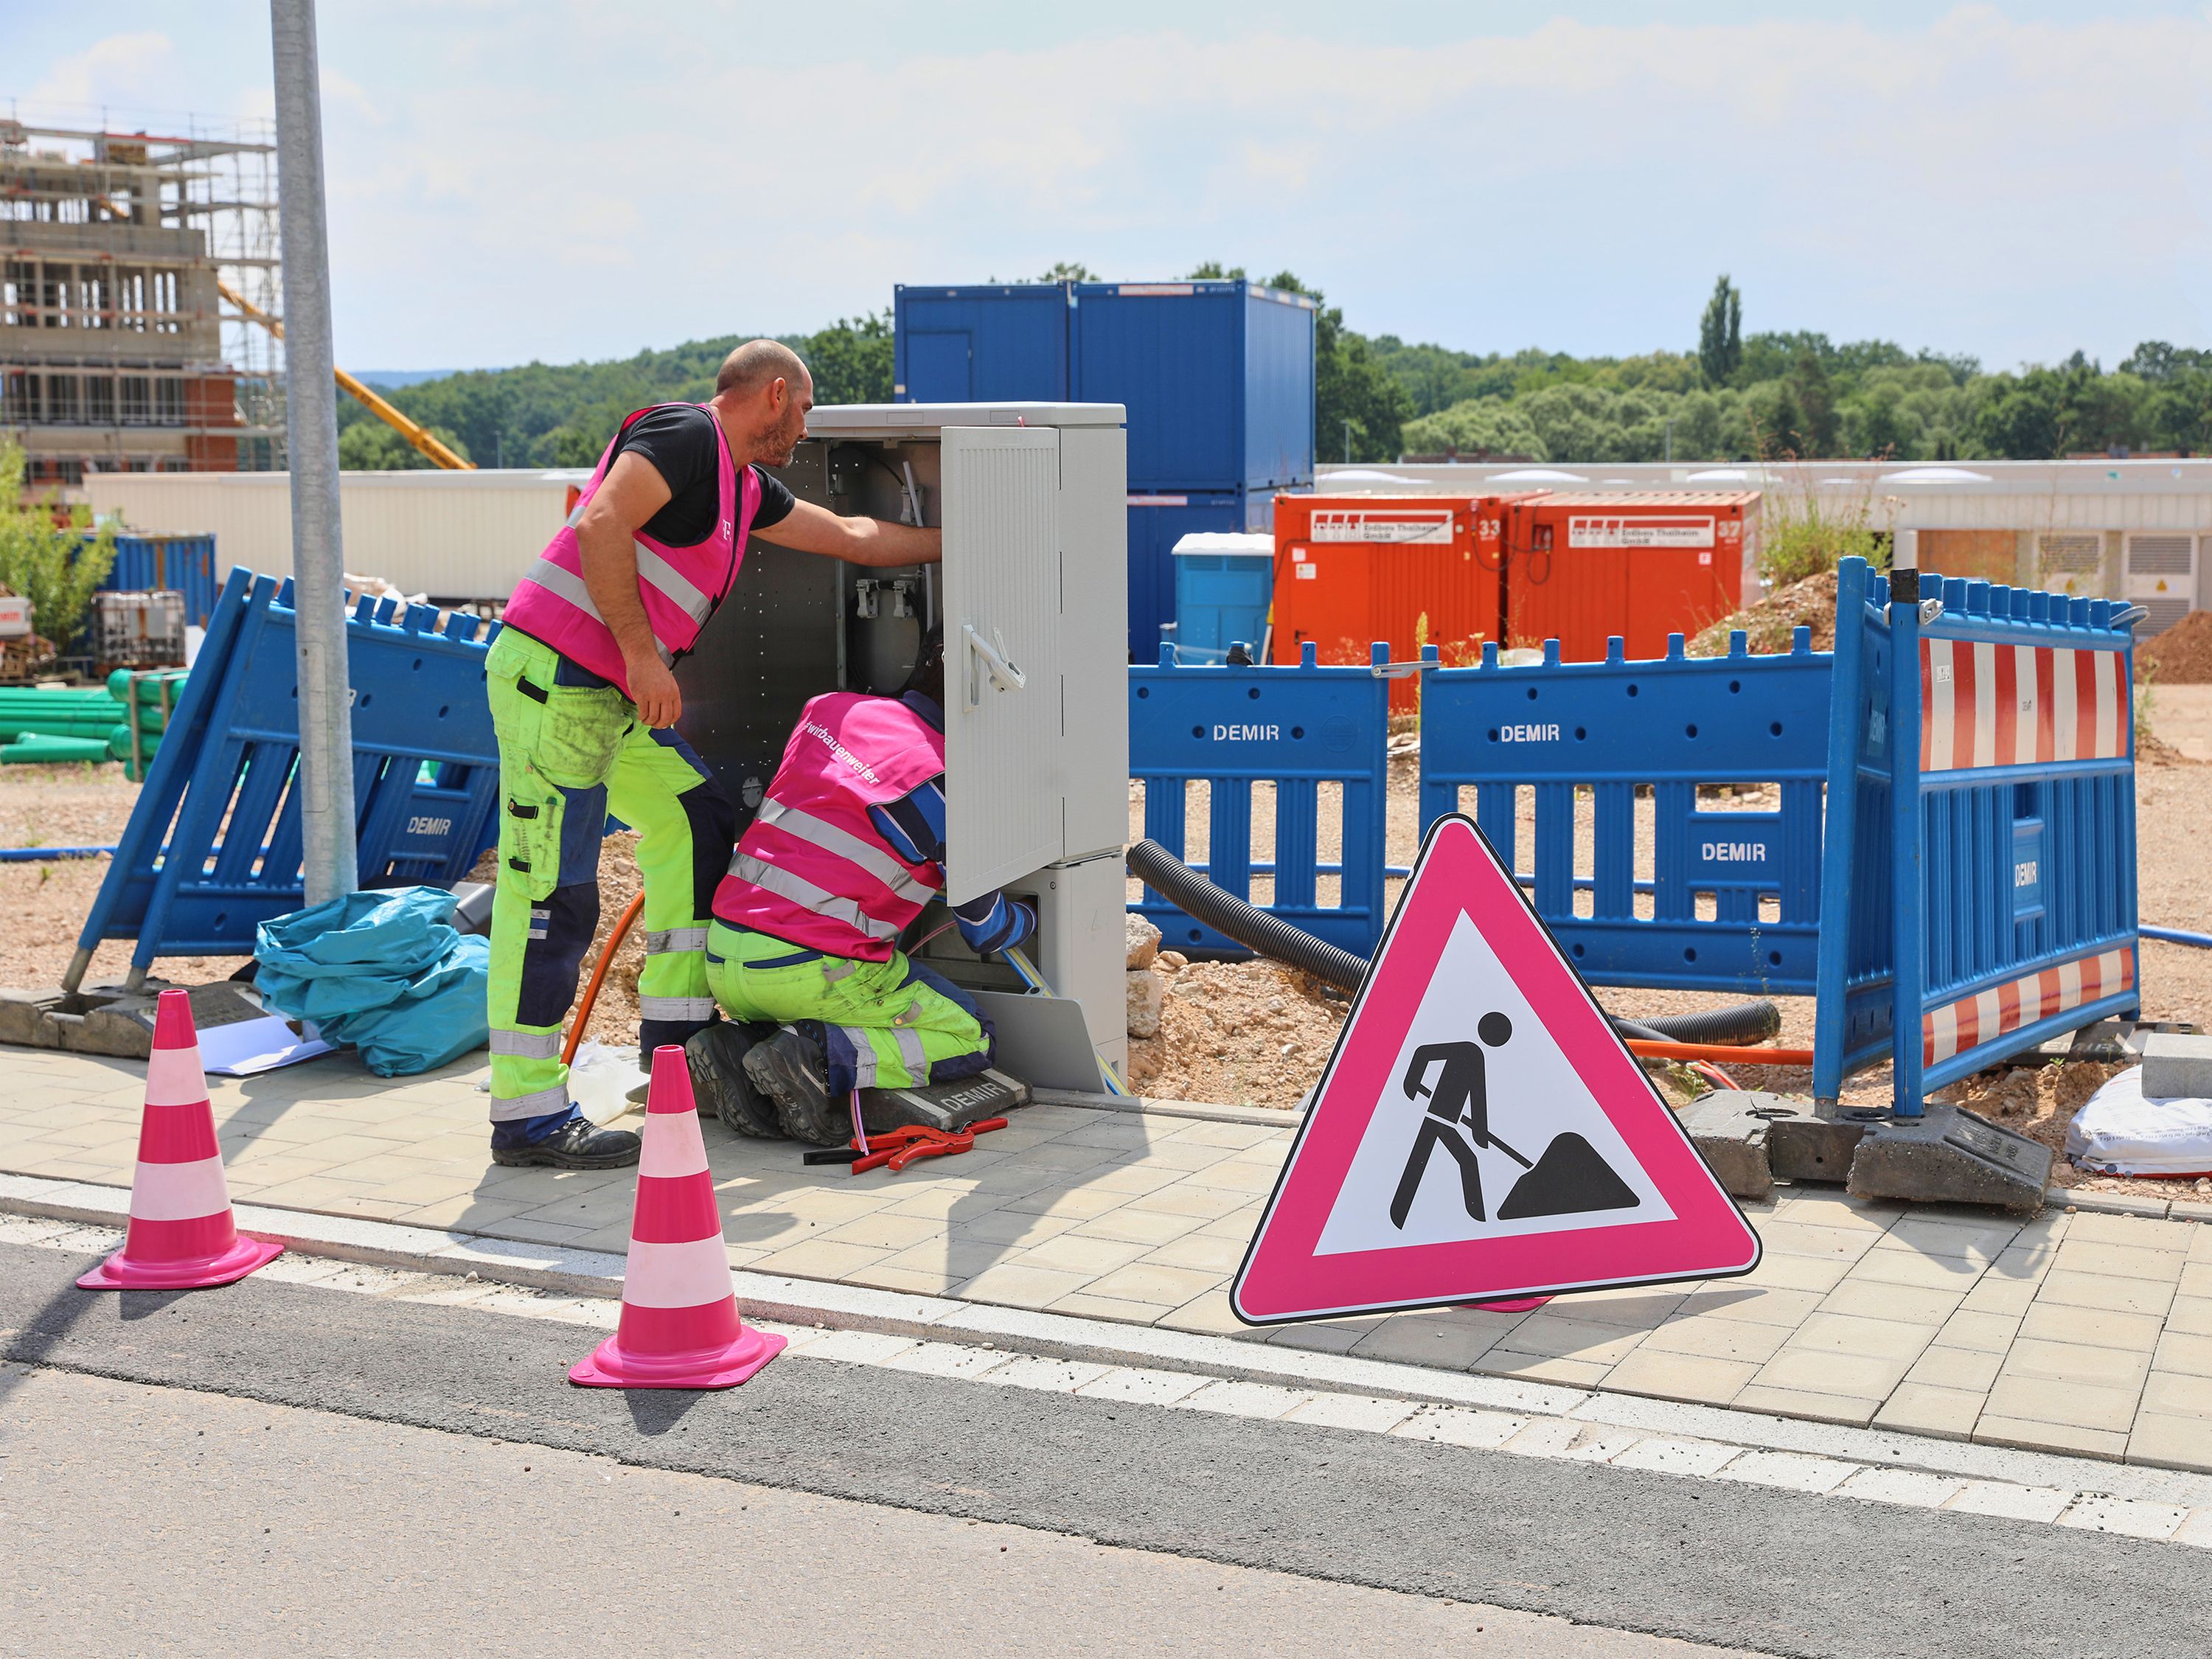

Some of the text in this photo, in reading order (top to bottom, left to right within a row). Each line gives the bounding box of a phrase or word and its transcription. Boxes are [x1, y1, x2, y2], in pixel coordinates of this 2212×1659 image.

[1479, 520, 1500, 536] 33
[1718, 521, 1741, 538] 37
[1213, 724, 1279, 741] DEMIR
[1501, 724, 1559, 742] DEMIR
[803, 720, 880, 785] #wirbauenweiter
[406, 816, 451, 835] DEMIR
[1702, 843, 1765, 861] DEMIR
[2015, 861, 2037, 887] DEMIR
[940, 1082, 1006, 1111] DEMIR
